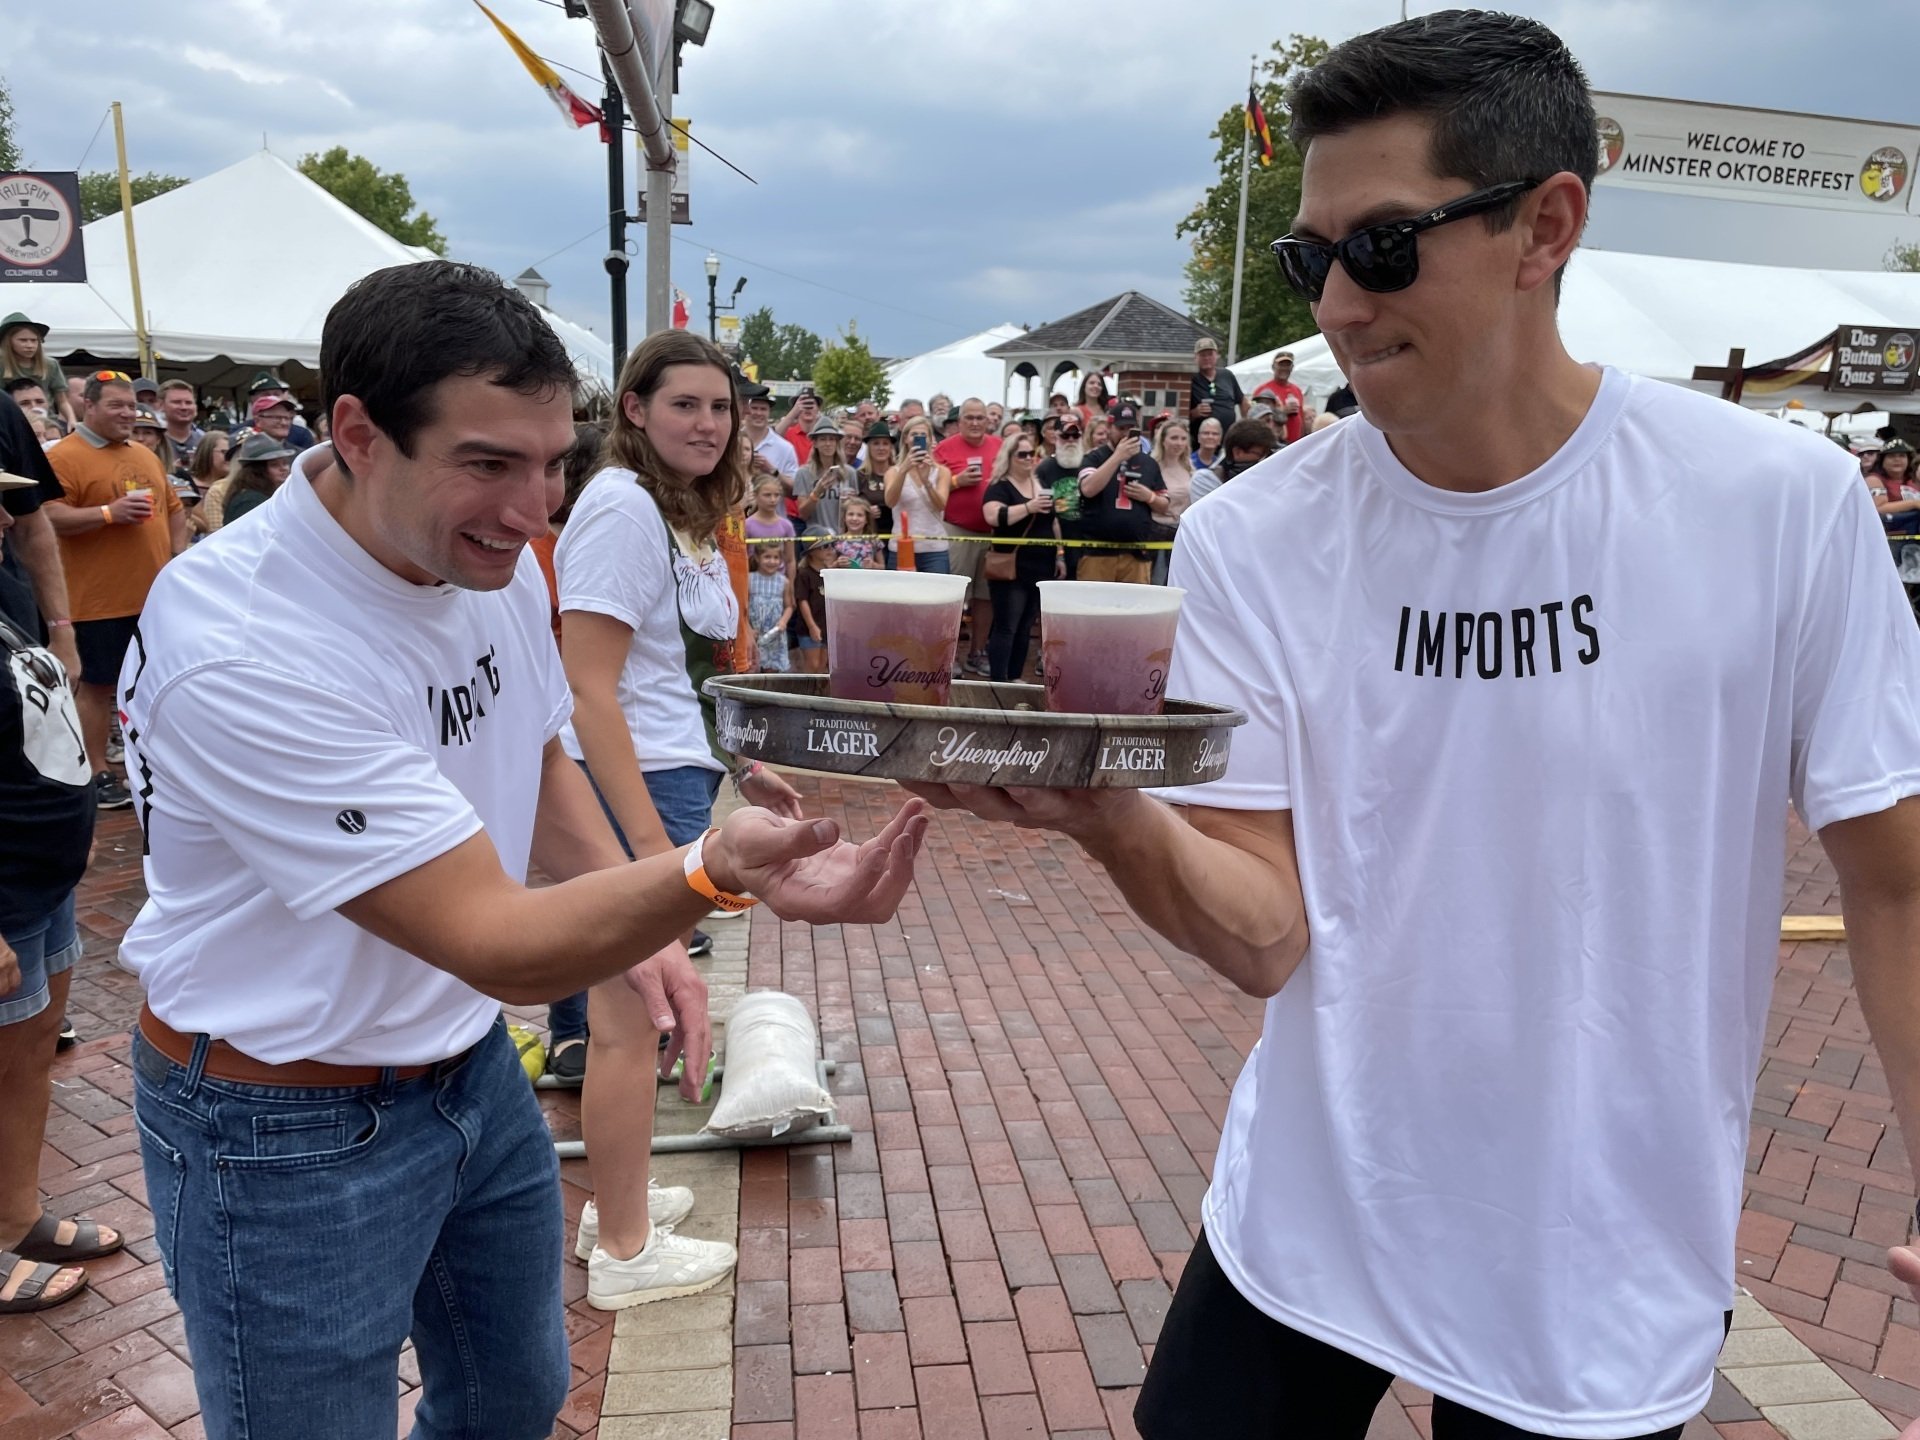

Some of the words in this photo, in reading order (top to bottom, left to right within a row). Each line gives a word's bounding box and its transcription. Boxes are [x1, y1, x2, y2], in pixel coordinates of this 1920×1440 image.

[1686, 131, 1778, 158] WELCOME
[1782, 141, 1805, 160] TO
[1623, 153, 1711, 179] MINSTER
[1716, 160, 1855, 192] OKTOBERFEST
[0, 183, 49, 201] AILSPIN
[1850, 329, 1878, 347] Das
[1838, 346, 1882, 366] Button
[1839, 366, 1875, 387] Haus
[1394, 594, 1600, 680] IMPORTS
[427, 643, 501, 746] IMPT
[723, 706, 769, 750] Yuengling
[815, 718, 871, 731] TRADITIONAL
[807, 729, 880, 757] LAGER
[929, 726, 1050, 774] Yuengling
[1111, 736, 1161, 747] TRADITIONAL
[1100, 747, 1166, 770] LAGER
